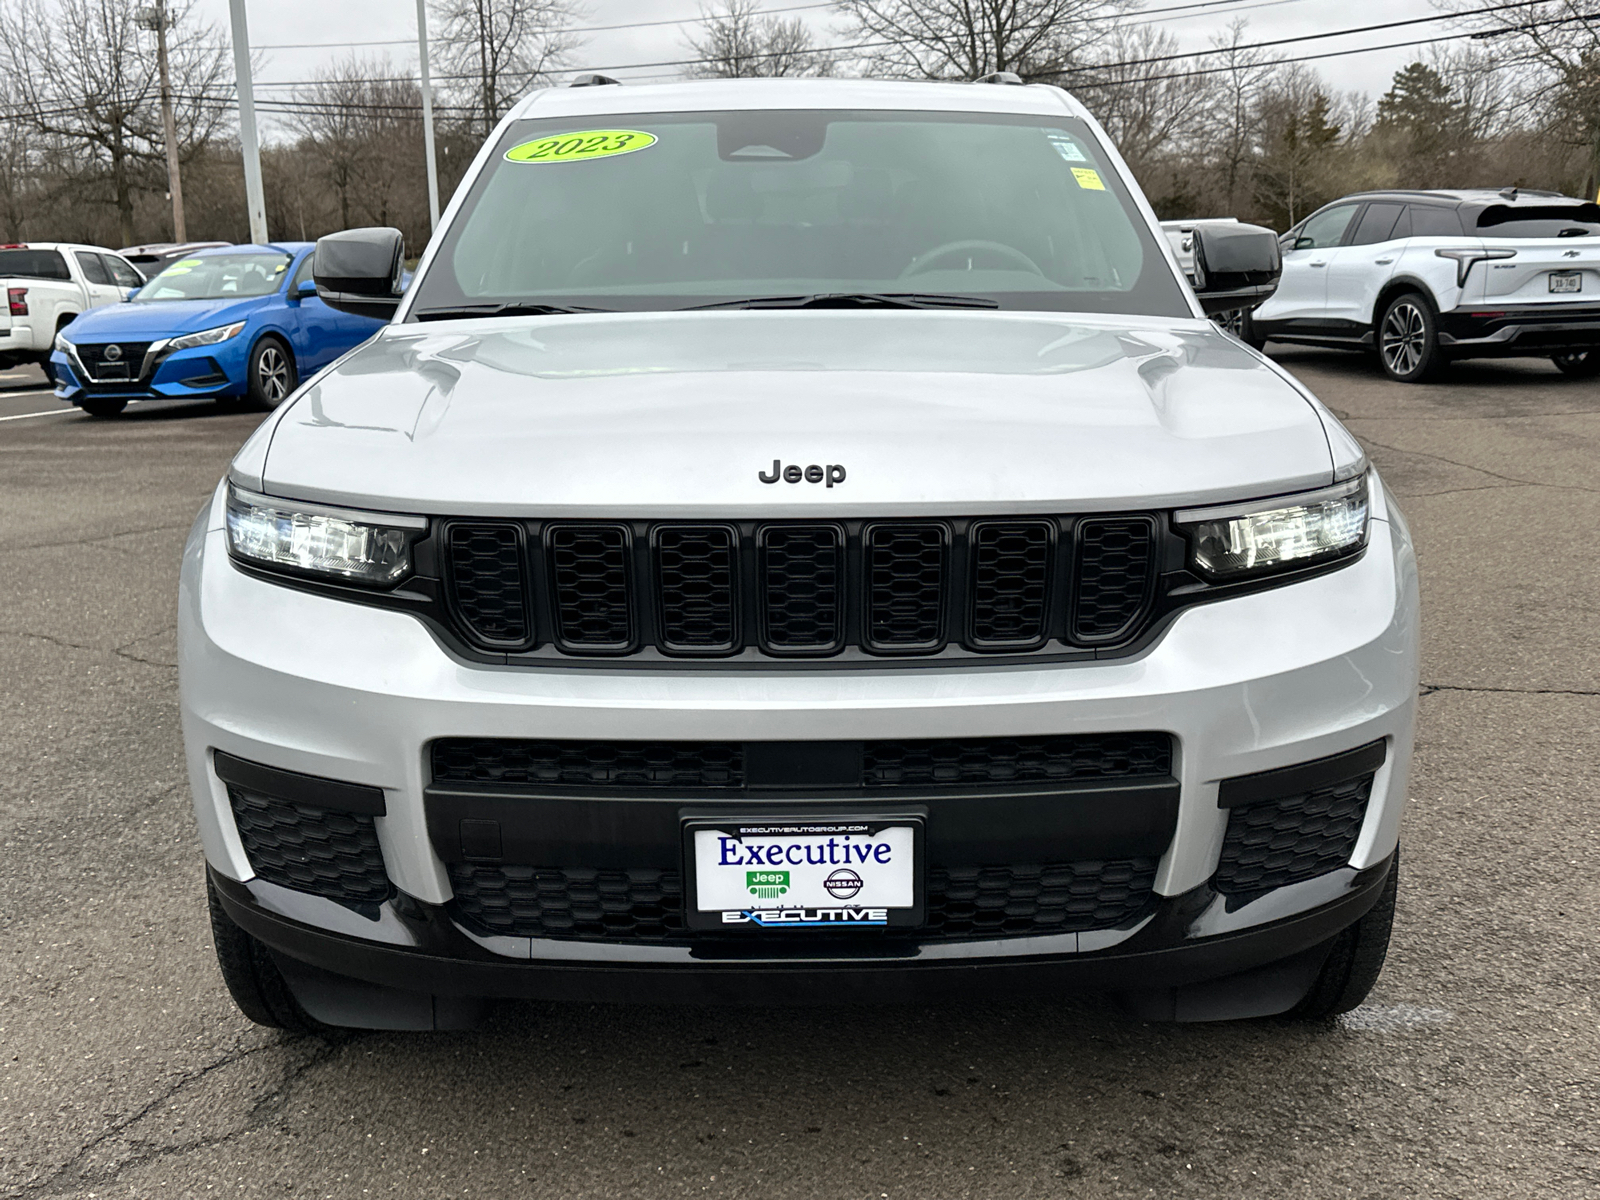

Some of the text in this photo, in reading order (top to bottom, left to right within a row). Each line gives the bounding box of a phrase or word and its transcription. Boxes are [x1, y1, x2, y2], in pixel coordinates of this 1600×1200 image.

[526, 134, 635, 160] 2023
[758, 459, 847, 488] Jeep
[740, 825, 869, 834] EXECUTIVEAUTOGROUP.COM
[717, 835, 892, 866] Executive
[752, 872, 784, 884] Jeep
[826, 880, 861, 888] NISSAN
[721, 908, 888, 924] EXECUTIVE
